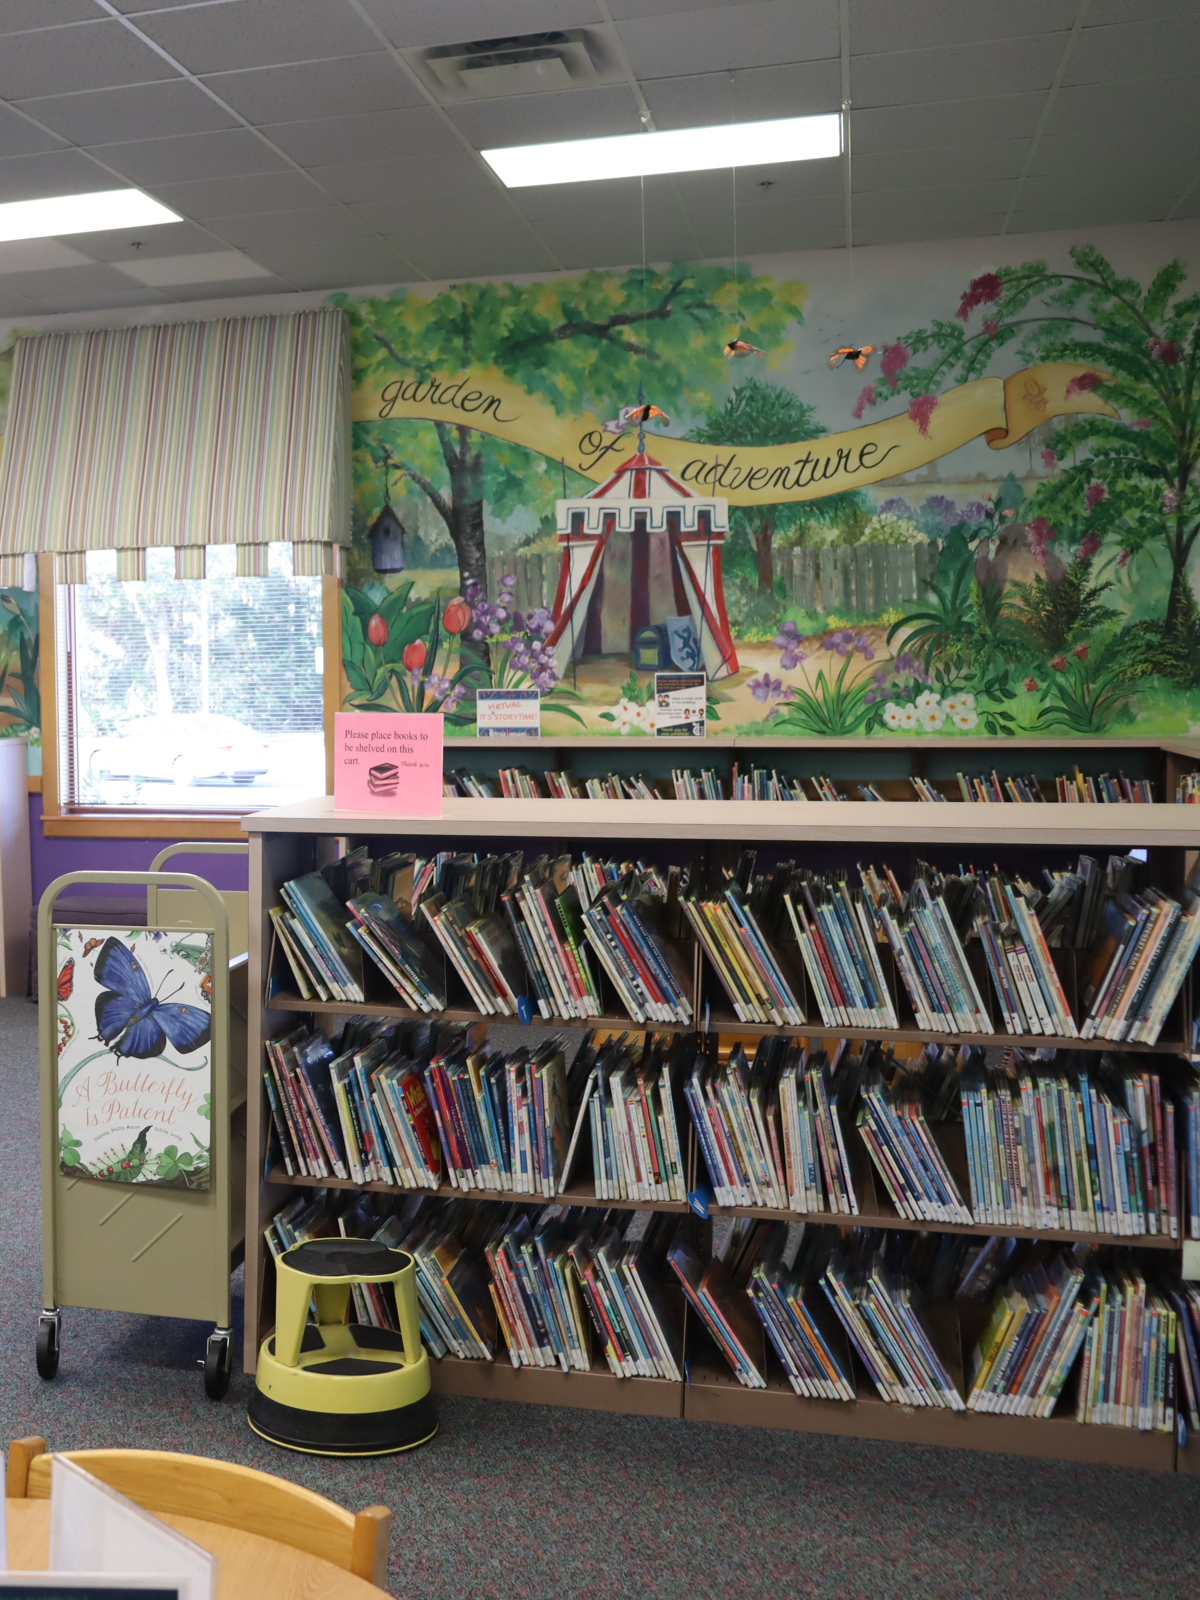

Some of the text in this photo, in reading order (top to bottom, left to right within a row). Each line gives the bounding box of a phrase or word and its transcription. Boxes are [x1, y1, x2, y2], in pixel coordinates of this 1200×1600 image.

[379, 376, 521, 422] garden
[680, 439, 901, 491] adventure
[488, 701, 522, 710] VIRTUAL
[344, 730, 369, 739] Please
[371, 730, 392, 741] place
[394, 731, 418, 741] books
[344, 743, 353, 751] be
[355, 744, 385, 752] shelved
[399, 745, 414, 753] this
[72, 1070, 198, 1112] A Butterfly
[84, 1098, 177, 1127] Is Patient
[154, 1126, 169, 1135] Sylvia
[171, 1132, 182, 1142] Long
